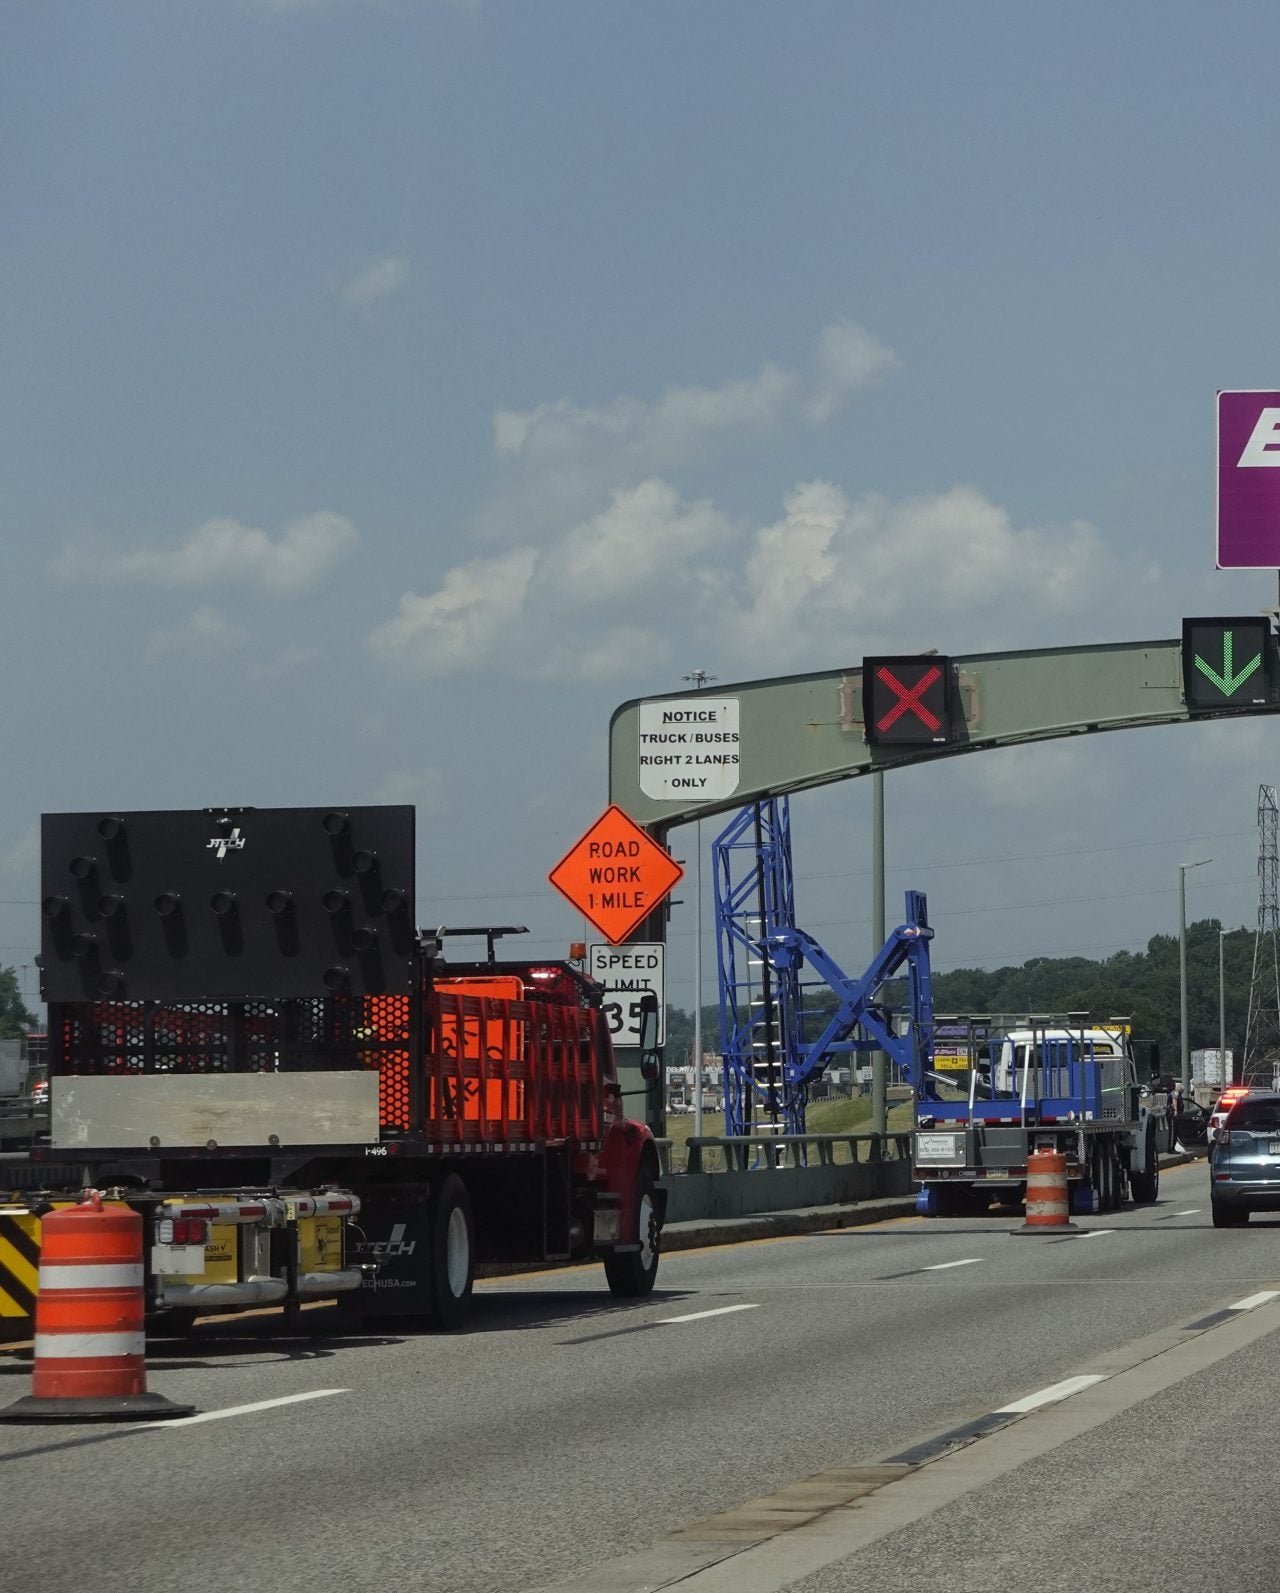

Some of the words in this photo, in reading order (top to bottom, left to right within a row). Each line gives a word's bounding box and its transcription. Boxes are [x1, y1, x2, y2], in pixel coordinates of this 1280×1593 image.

[663, 711, 717, 722] NOTICE
[640, 755, 682, 766] RIGHT
[685, 755, 693, 765] 2
[695, 754, 739, 766] LANES
[671, 777, 707, 788] ONLY
[589, 840, 640, 859] ROAD
[589, 866, 641, 884] WORK
[588, 893, 594, 909] 1
[601, 891, 645, 909] MILE
[596, 955, 659, 969] SPEED
